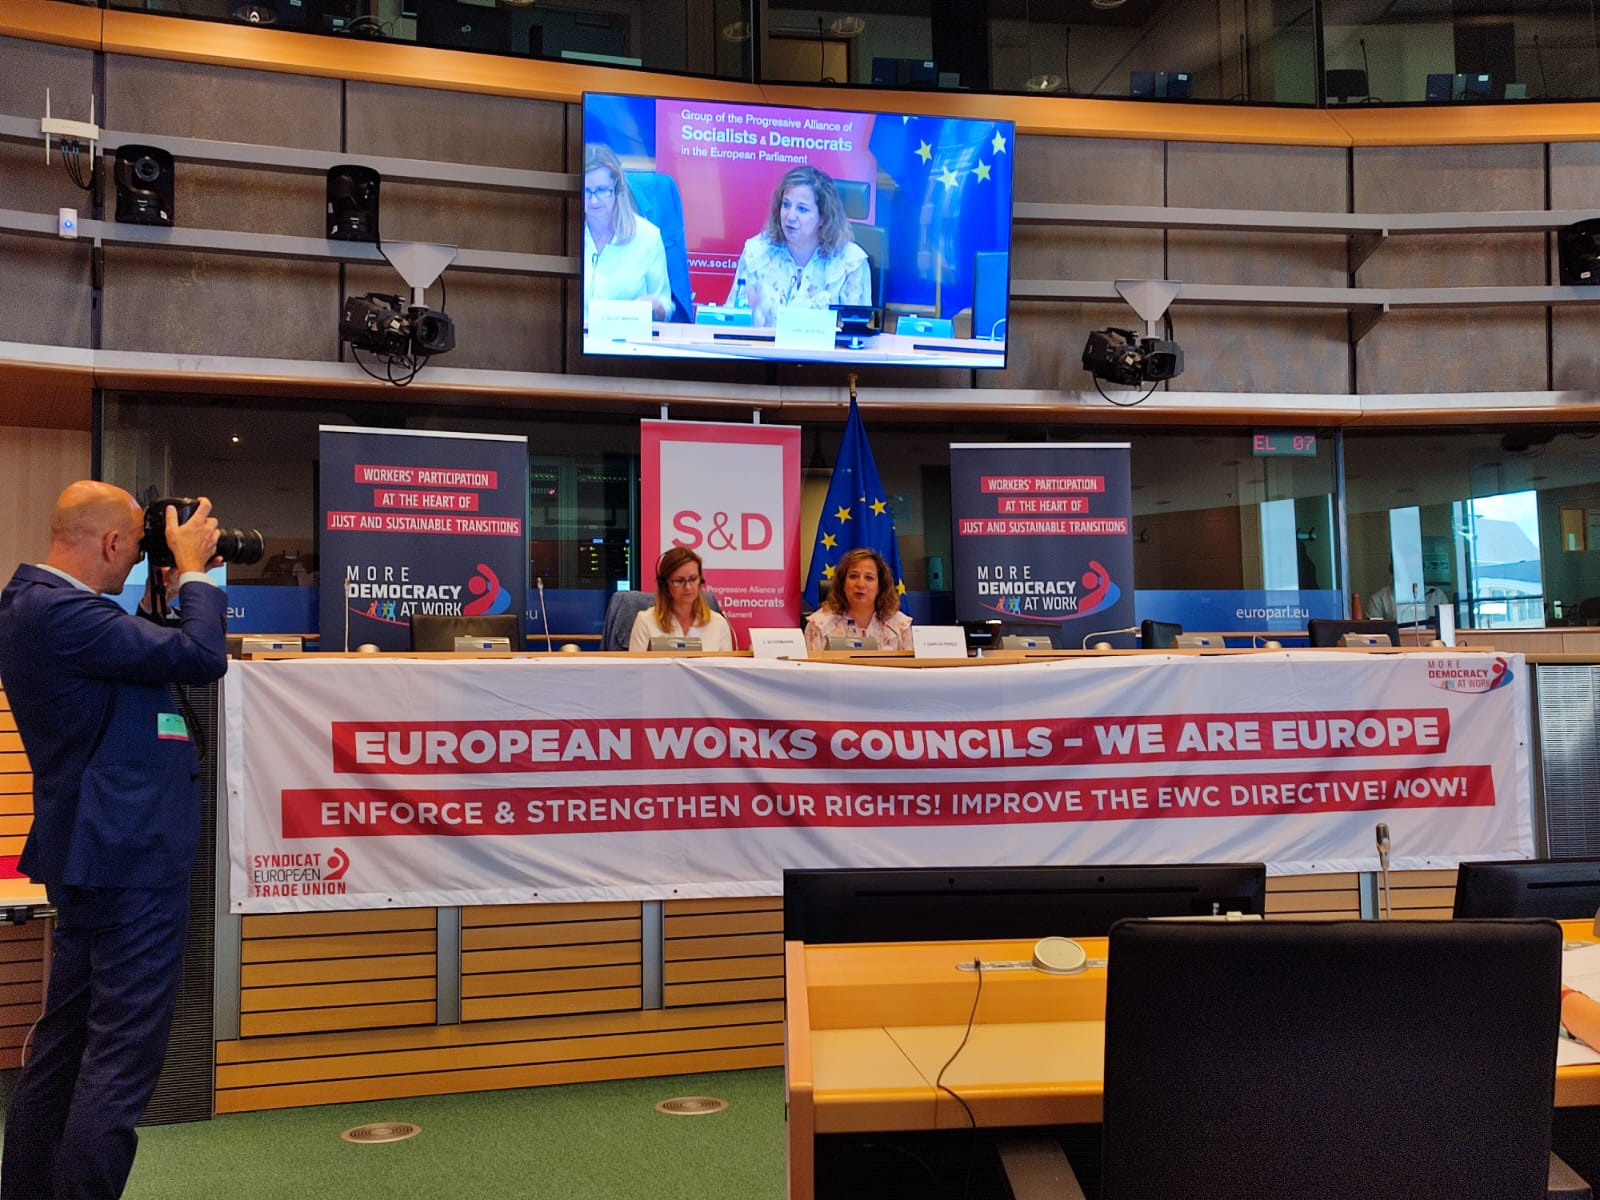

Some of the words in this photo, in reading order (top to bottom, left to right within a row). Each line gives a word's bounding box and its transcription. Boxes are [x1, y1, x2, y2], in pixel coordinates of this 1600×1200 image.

[681, 109, 713, 122] Group
[715, 112, 725, 122] of
[728, 113, 743, 124] the
[746, 114, 801, 129] Progressive
[804, 119, 840, 131] Alliance
[843, 122, 852, 132] of
[682, 125, 757, 145] Socialists
[760, 136, 767, 145] &
[769, 132, 853, 151] Democrats
[681, 146, 689, 155] in
[692, 147, 707, 157] the
[711, 148, 756, 161] European
[758, 151, 808, 164] Parliament
[1253, 434, 1277, 451] EL
[1293, 434, 1315, 451] 07
[363, 467, 414, 482] WORKERS'
[418, 471, 489, 486] PARTICIPATION
[988, 479, 1031, 491] WORKERS'
[1035, 479, 1097, 491] PARTICIPATION
[382, 493, 395, 505] AT
[399, 494, 418, 506] THE
[422, 494, 455, 508] HEART
[458, 496, 471, 508] OF
[1005, 500, 1016, 512] AT
[1019, 500, 1036, 511] THE
[1040, 500, 1067, 511] HEART
[1071, 500, 1082, 511] OF
[331, 515, 356, 528] JUST
[360, 516, 382, 529] AND
[386, 517, 452, 531] SUSTAINABLE
[456, 519, 519, 534] TRANSITIONS
[672, 510, 773, 551] S&D
[962, 522, 983, 533] JUST
[987, 522, 1006, 533] AND
[1009, 521, 1066, 533] SUSTAINABLE
[1069, 521, 1126, 532] TRANSITIONS
[346, 565, 409, 581] MORE
[977, 565, 1031, 580] MORE
[348, 583, 462, 600] DEMOCRACY
[706, 585, 747, 595] Progressive
[749, 586, 775, 594] Alliance
[978, 581, 1077, 595] DEMOCRACY
[400, 602, 418, 616] AT
[421, 602, 462, 616] WORK
[724, 597, 784, 608] Democrats
[1024, 597, 1040, 610] AT
[1042, 597, 1077, 610] WORK
[1236, 606, 1310, 622] europarl.eu
[1428, 660, 1461, 668] MORE
[1428, 669, 1488, 679] DEMOCRACY
[1457, 680, 1467, 688] AT
[1469, 679, 1490, 688] WORK
[354, 727, 632, 765] EUROPEAN
[645, 726, 818, 760] WORKS
[830, 726, 1053, 760] COUNCILS
[1094, 723, 1165, 756] WE
[1176, 720, 1261, 752] ARE
[1271, 716, 1440, 751] EUROPE
[321, 801, 484, 826] ENFORCE
[494, 801, 515, 824] &
[527, 795, 740, 823] STRENGTHEN
[751, 794, 817, 818] OUR
[825, 793, 941, 817] RIGHTS!
[952, 790, 1083, 815] IMPROVE
[1091, 787, 1149, 811] THE
[1157, 785, 1220, 809] EWC
[1230, 780, 1387, 807] DIRECTIVE!
[1393, 776, 1468, 800] NOW!
[254, 853, 321, 868] SYNDICAT
[254, 884, 298, 898] TRADE
[302, 882, 347, 896] UNION
